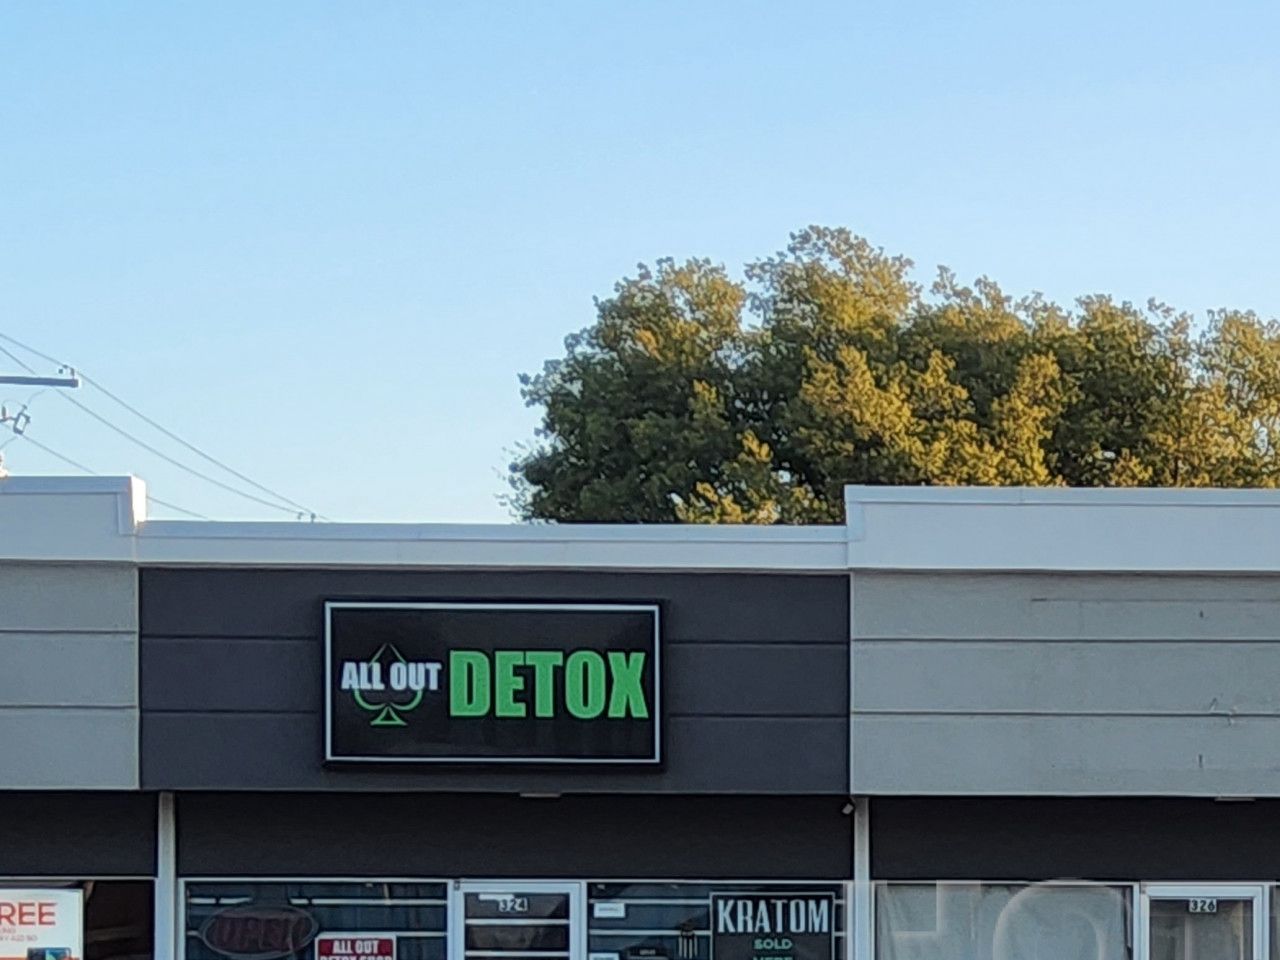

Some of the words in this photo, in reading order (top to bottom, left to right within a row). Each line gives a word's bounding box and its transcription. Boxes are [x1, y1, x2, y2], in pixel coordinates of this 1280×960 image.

[341, 662, 385, 690] ALL
[389, 662, 442, 691] OUT
[449, 650, 649, 719] DETOX
[498, 897, 528, 913] 324
[1191, 899, 1215, 912] 326
[717, 899, 829, 933] KRATOM
[332, 940, 353, 954] ALL
[355, 940, 379, 954] OUT
[753, 938, 793, 951] SOLD
